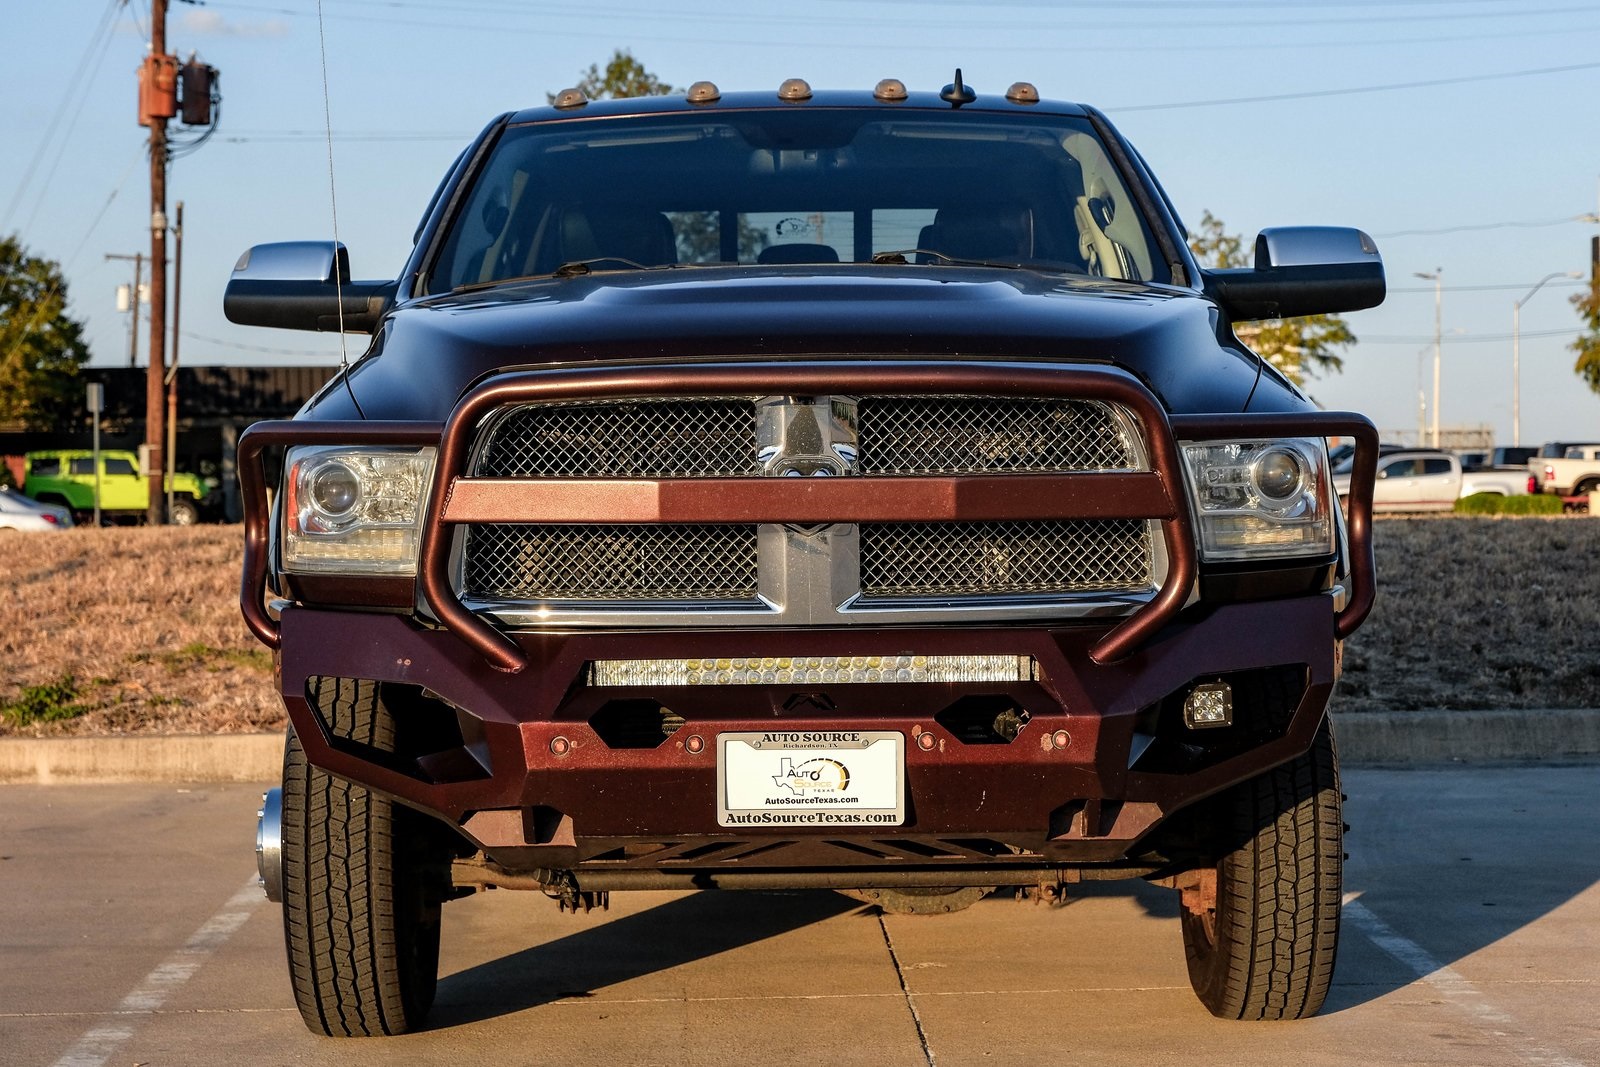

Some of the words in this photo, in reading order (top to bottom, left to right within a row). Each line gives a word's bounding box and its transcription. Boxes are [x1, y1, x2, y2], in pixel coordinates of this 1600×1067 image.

[762, 733, 800, 742] AUTO
[803, 733, 859, 742] SOURCE
[765, 796, 859, 805] AutoSourceTexas.com
[725, 812, 897, 824] AutoSourceTexas.com
